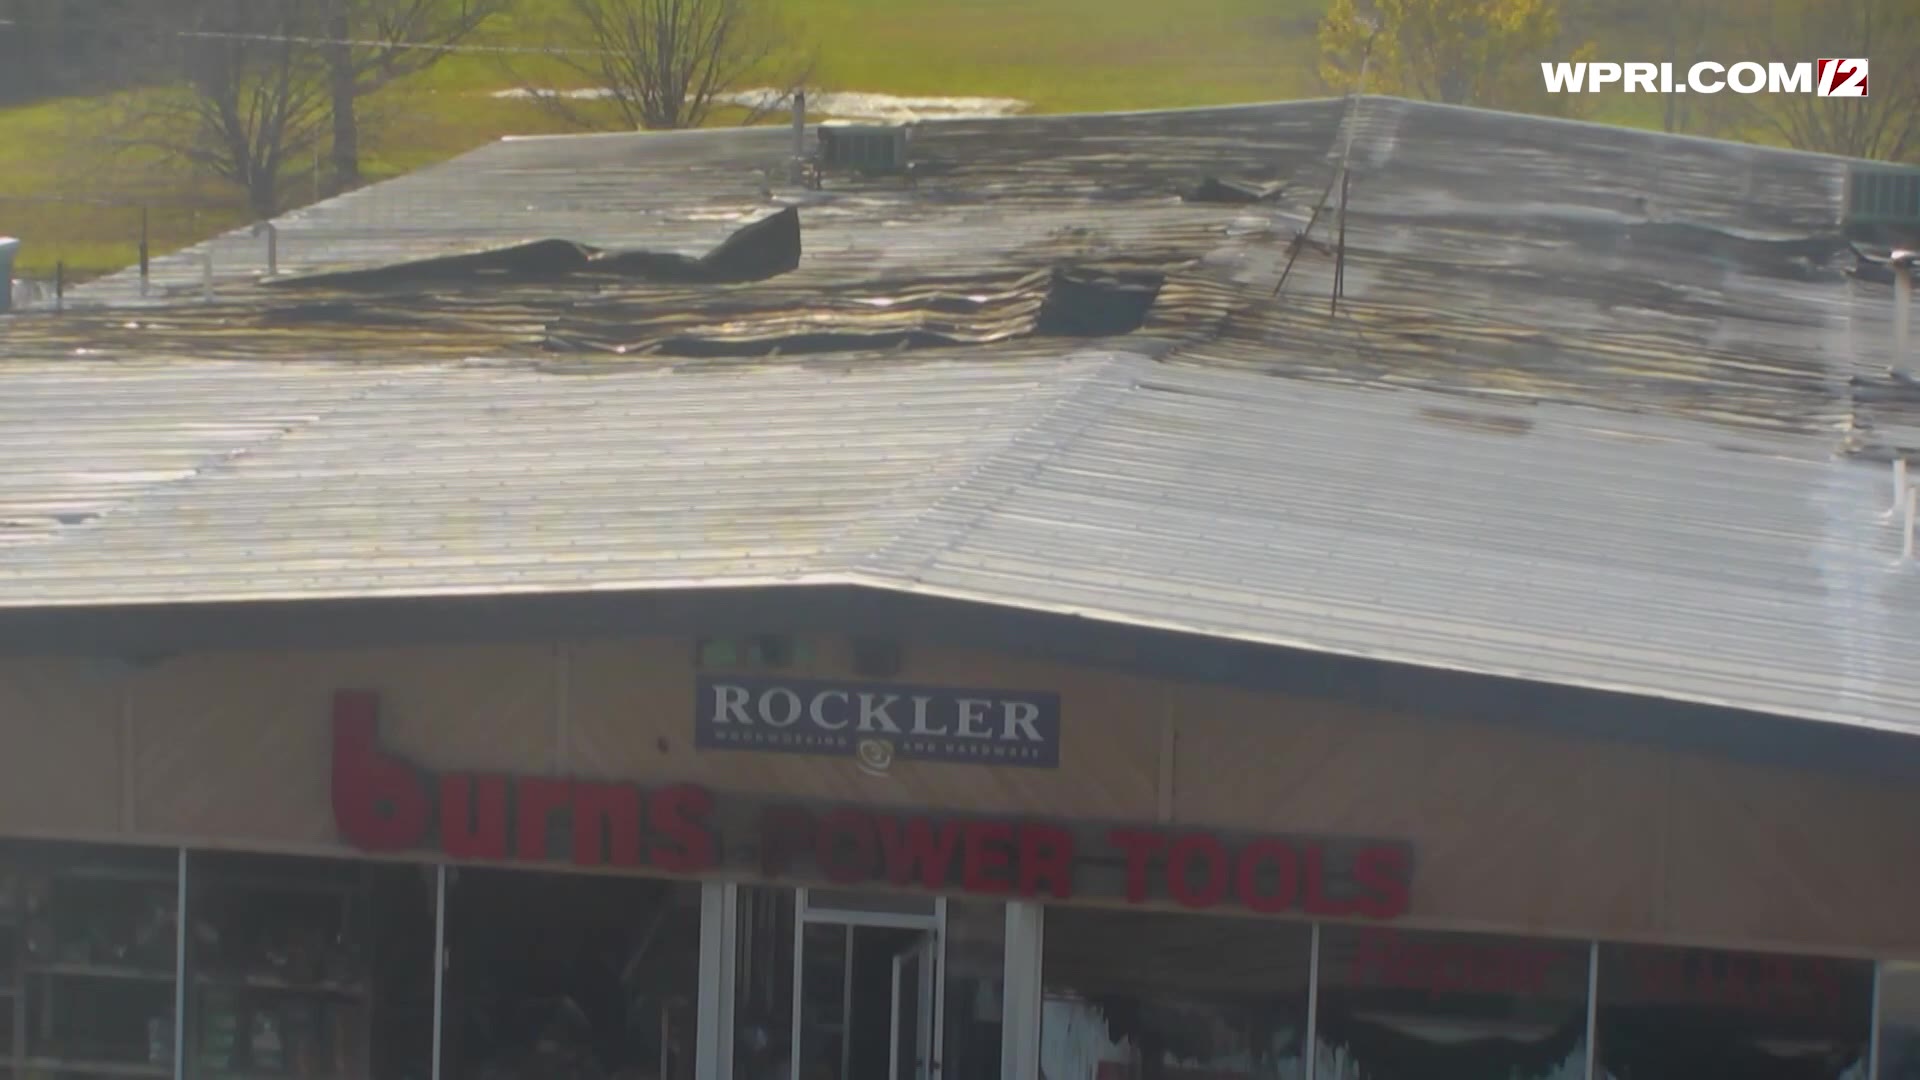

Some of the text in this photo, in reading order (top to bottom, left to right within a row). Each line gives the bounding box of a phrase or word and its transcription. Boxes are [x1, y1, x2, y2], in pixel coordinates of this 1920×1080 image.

[711, 684, 1044, 741] ROCKLER
[332, 689, 1412, 920] burns POWER TOOLS
